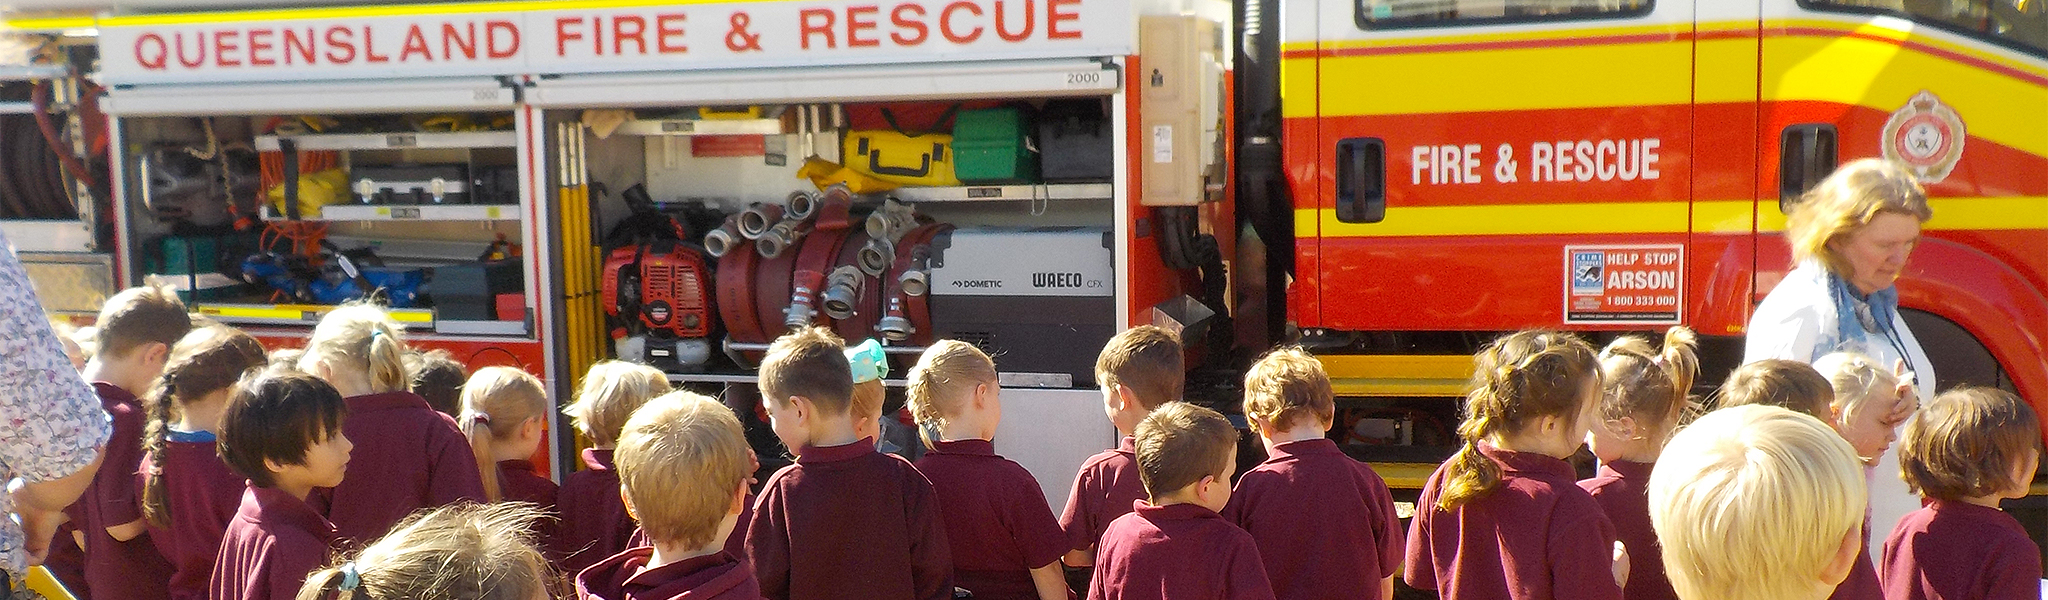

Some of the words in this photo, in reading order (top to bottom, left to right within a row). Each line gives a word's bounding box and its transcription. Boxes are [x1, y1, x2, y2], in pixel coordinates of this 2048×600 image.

[134, 21, 521, 70] QUEENSLAND
[556, 14, 688, 56] FIRE
[724, 11, 762, 53] &
[800, 0, 1083, 50] RESCUE
[1067, 73, 1100, 83] 2000
[1412, 144, 1482, 185] FIRE
[1494, 144, 1518, 184] &
[1531, 138, 1660, 182] RESCUE
[1607, 253, 1639, 265] HELP
[1645, 253, 1677, 265] STOP
[964, 280, 1002, 288] DOMETIC
[1032, 273, 1082, 288] WAECO
[1086, 279, 1103, 288] CFX
[1607, 270, 1675, 290] ARSON
[1607, 296, 1612, 306] 1
[1614, 296, 1633, 306] 800
[1656, 296, 1676, 306] 000
